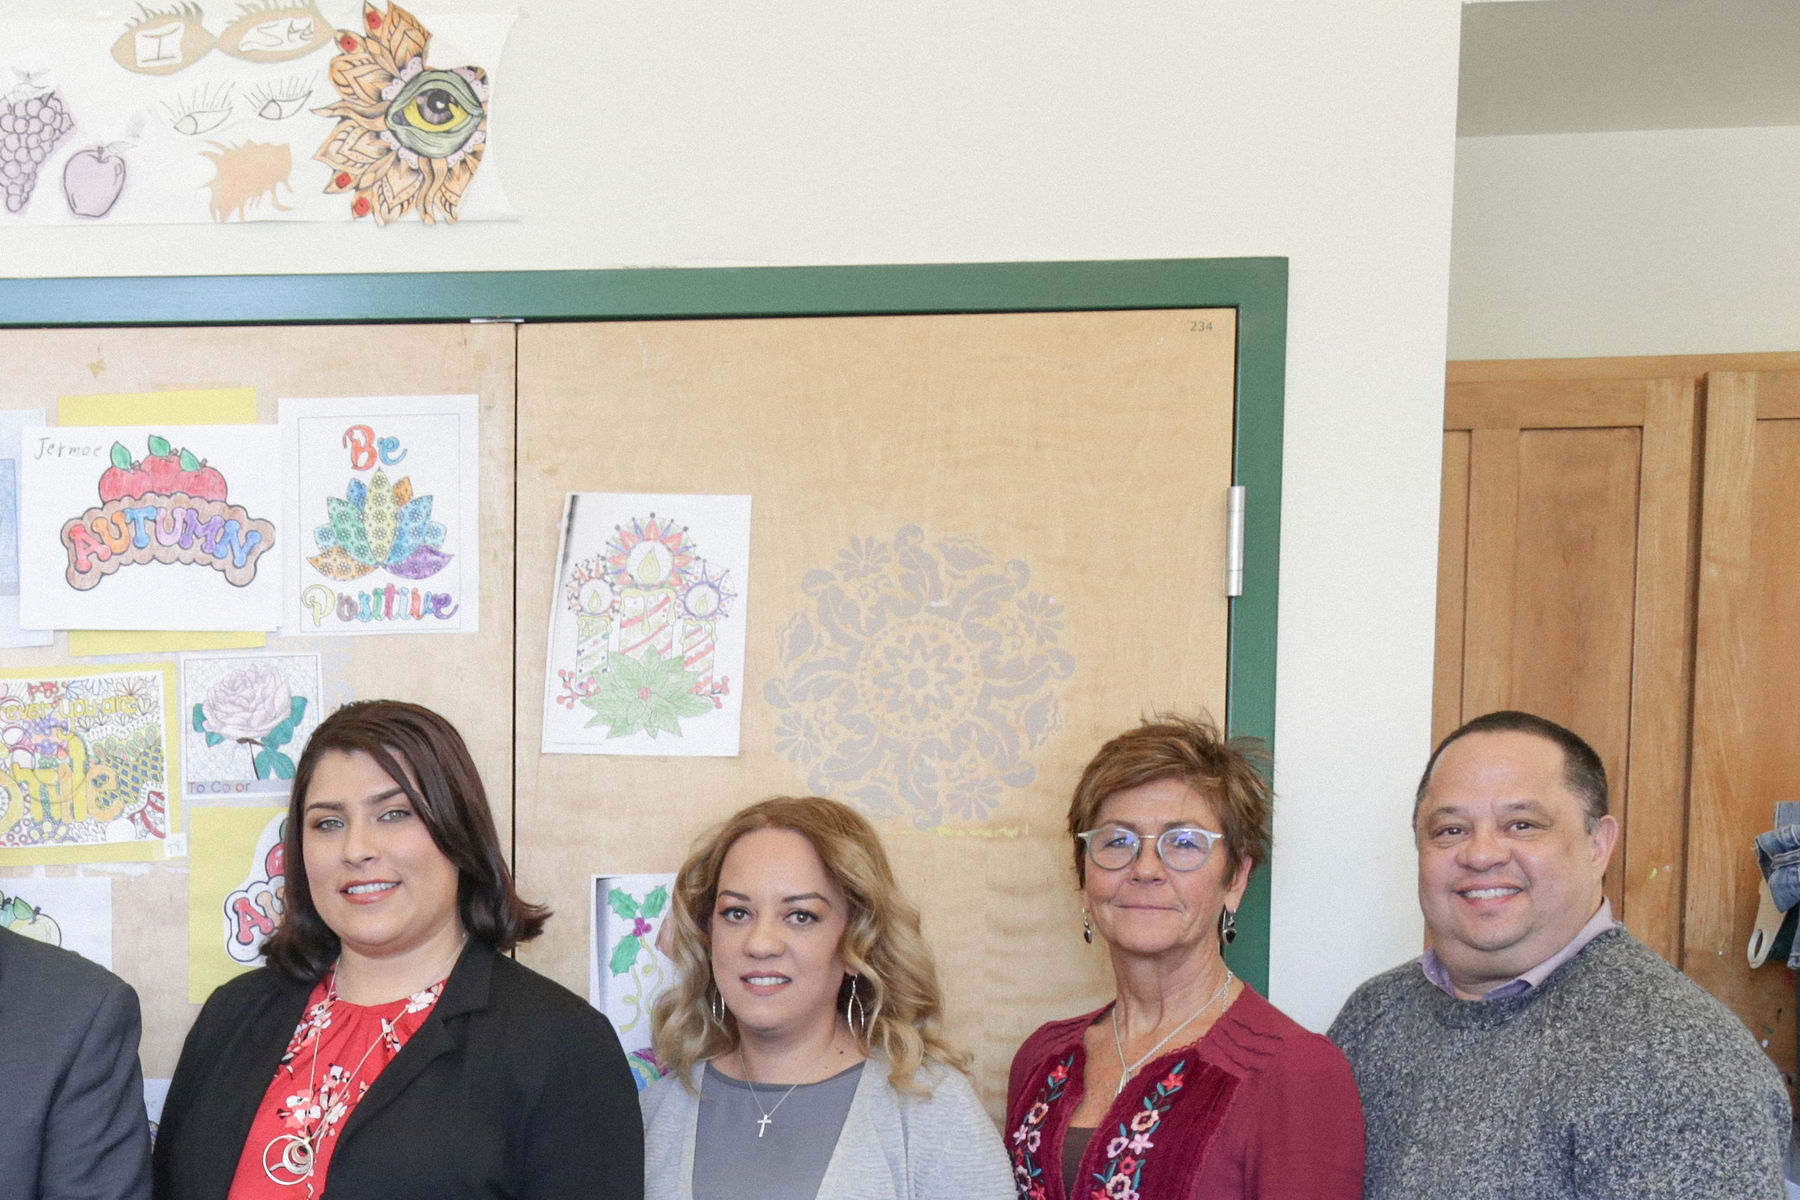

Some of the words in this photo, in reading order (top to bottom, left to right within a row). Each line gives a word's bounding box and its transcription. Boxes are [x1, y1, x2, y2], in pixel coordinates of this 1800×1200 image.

[1190, 320, 1213, 332] 234
[342, 424, 408, 471] Be
[69, 505, 262, 574] AUTUMN
[301, 583, 459, 627] Positive
[188, 781, 206, 794] To
[210, 780, 251, 794] Color
